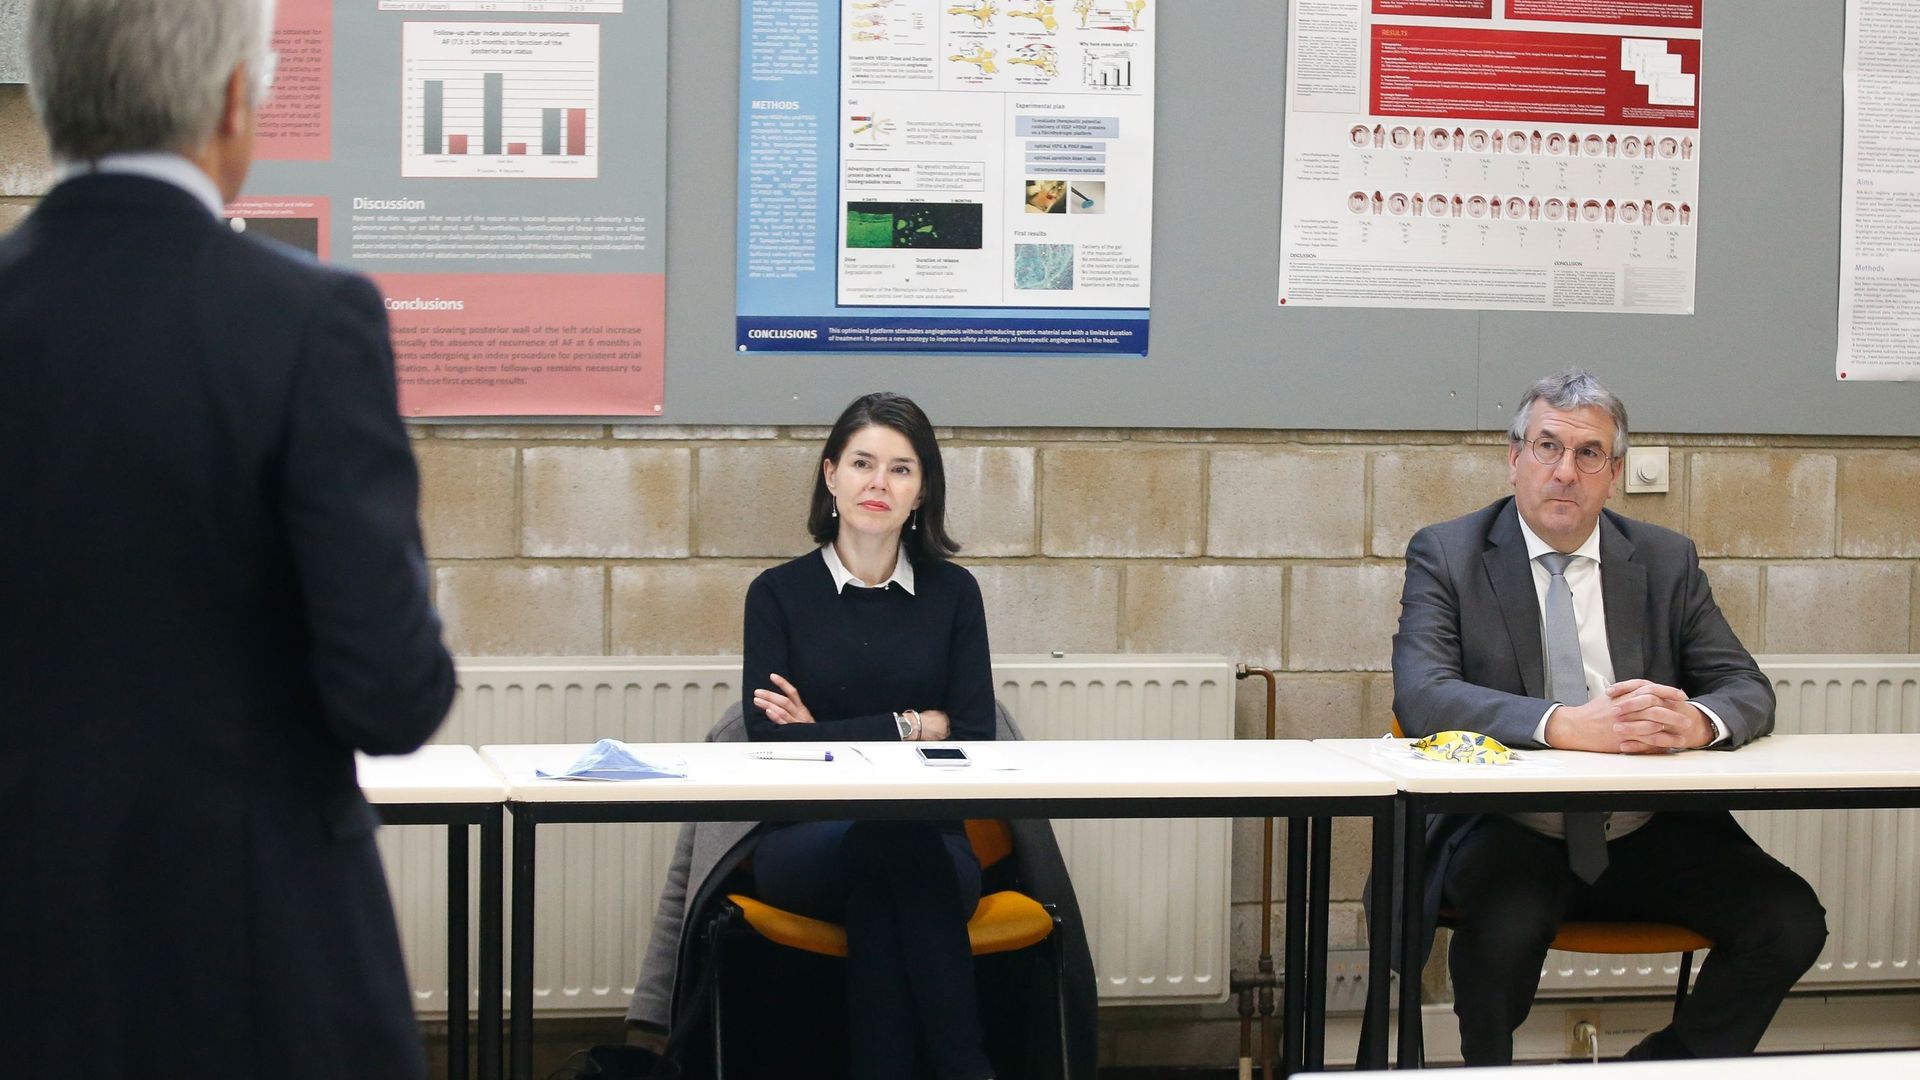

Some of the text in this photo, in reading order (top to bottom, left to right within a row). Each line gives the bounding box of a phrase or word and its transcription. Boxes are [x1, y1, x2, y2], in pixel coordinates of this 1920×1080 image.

[752, 100, 799, 110] METHODS
[353, 198, 424, 210] Discussion
[1856, 264, 1885, 272] Methods
[384, 298, 464, 310] Conclusions
[748, 330, 817, 338] CONCLUSIONS
